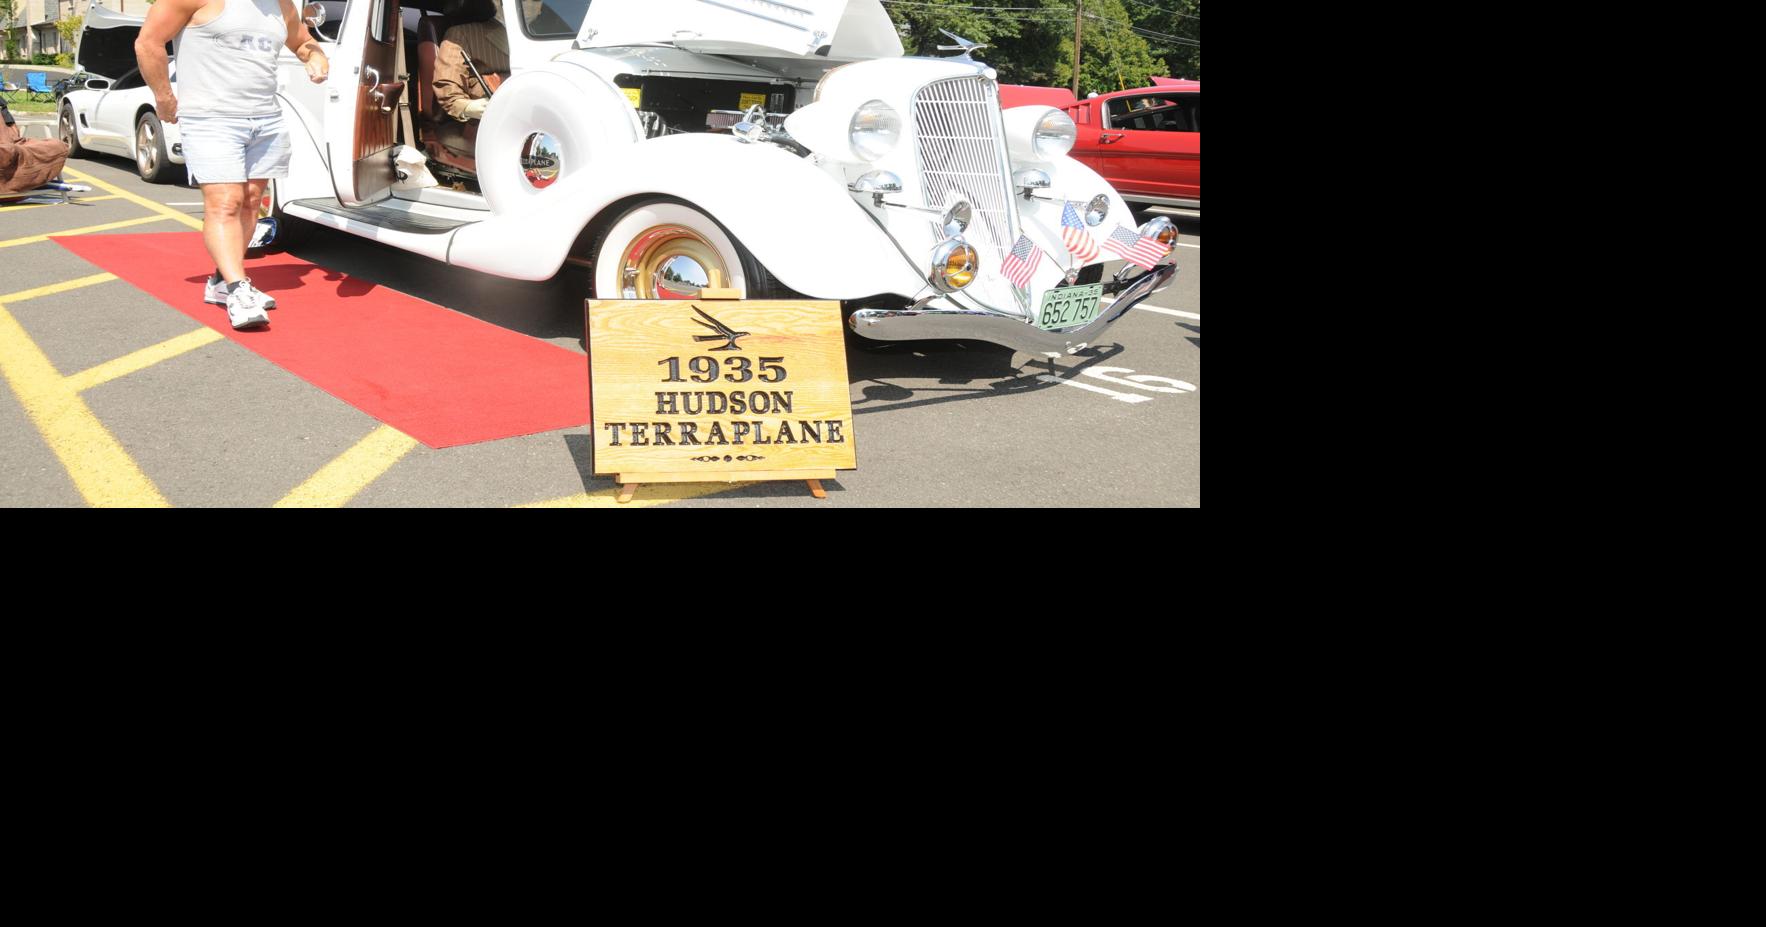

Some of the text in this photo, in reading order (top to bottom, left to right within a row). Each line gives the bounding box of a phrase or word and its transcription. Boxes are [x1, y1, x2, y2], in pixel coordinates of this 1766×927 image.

[1041, 296, 1098, 325] 652 757
[657, 356, 788, 383] 1935
[654, 390, 794, 415] HUDSON
[604, 420, 845, 446] TERRAPLANE
